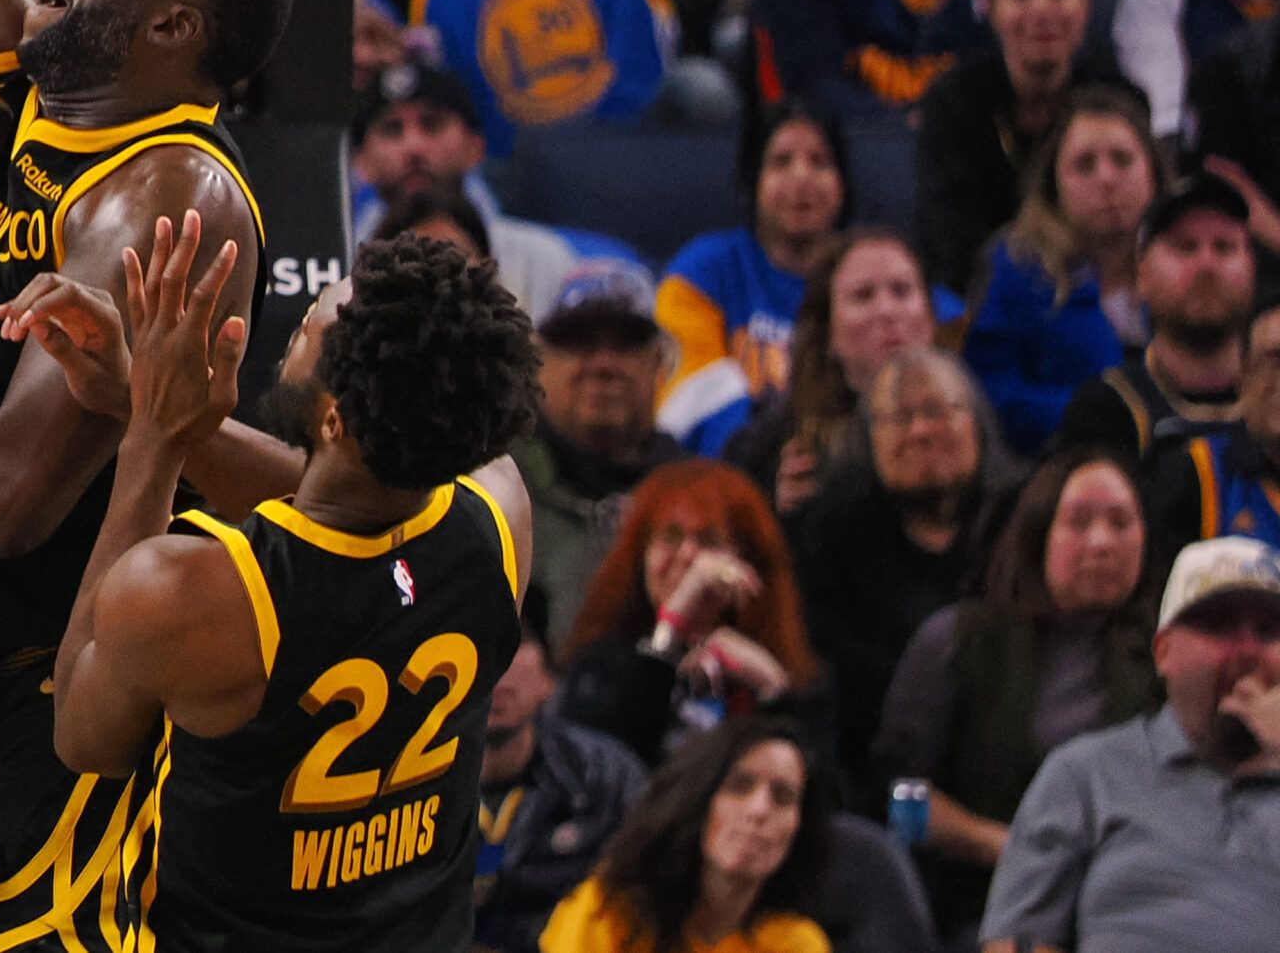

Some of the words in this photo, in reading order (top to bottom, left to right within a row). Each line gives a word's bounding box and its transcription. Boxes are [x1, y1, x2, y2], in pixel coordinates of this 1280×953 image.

[266, 256, 341, 296] SH
[279, 632, 479, 814] 22
[291, 794, 441, 891] WIGGINS
